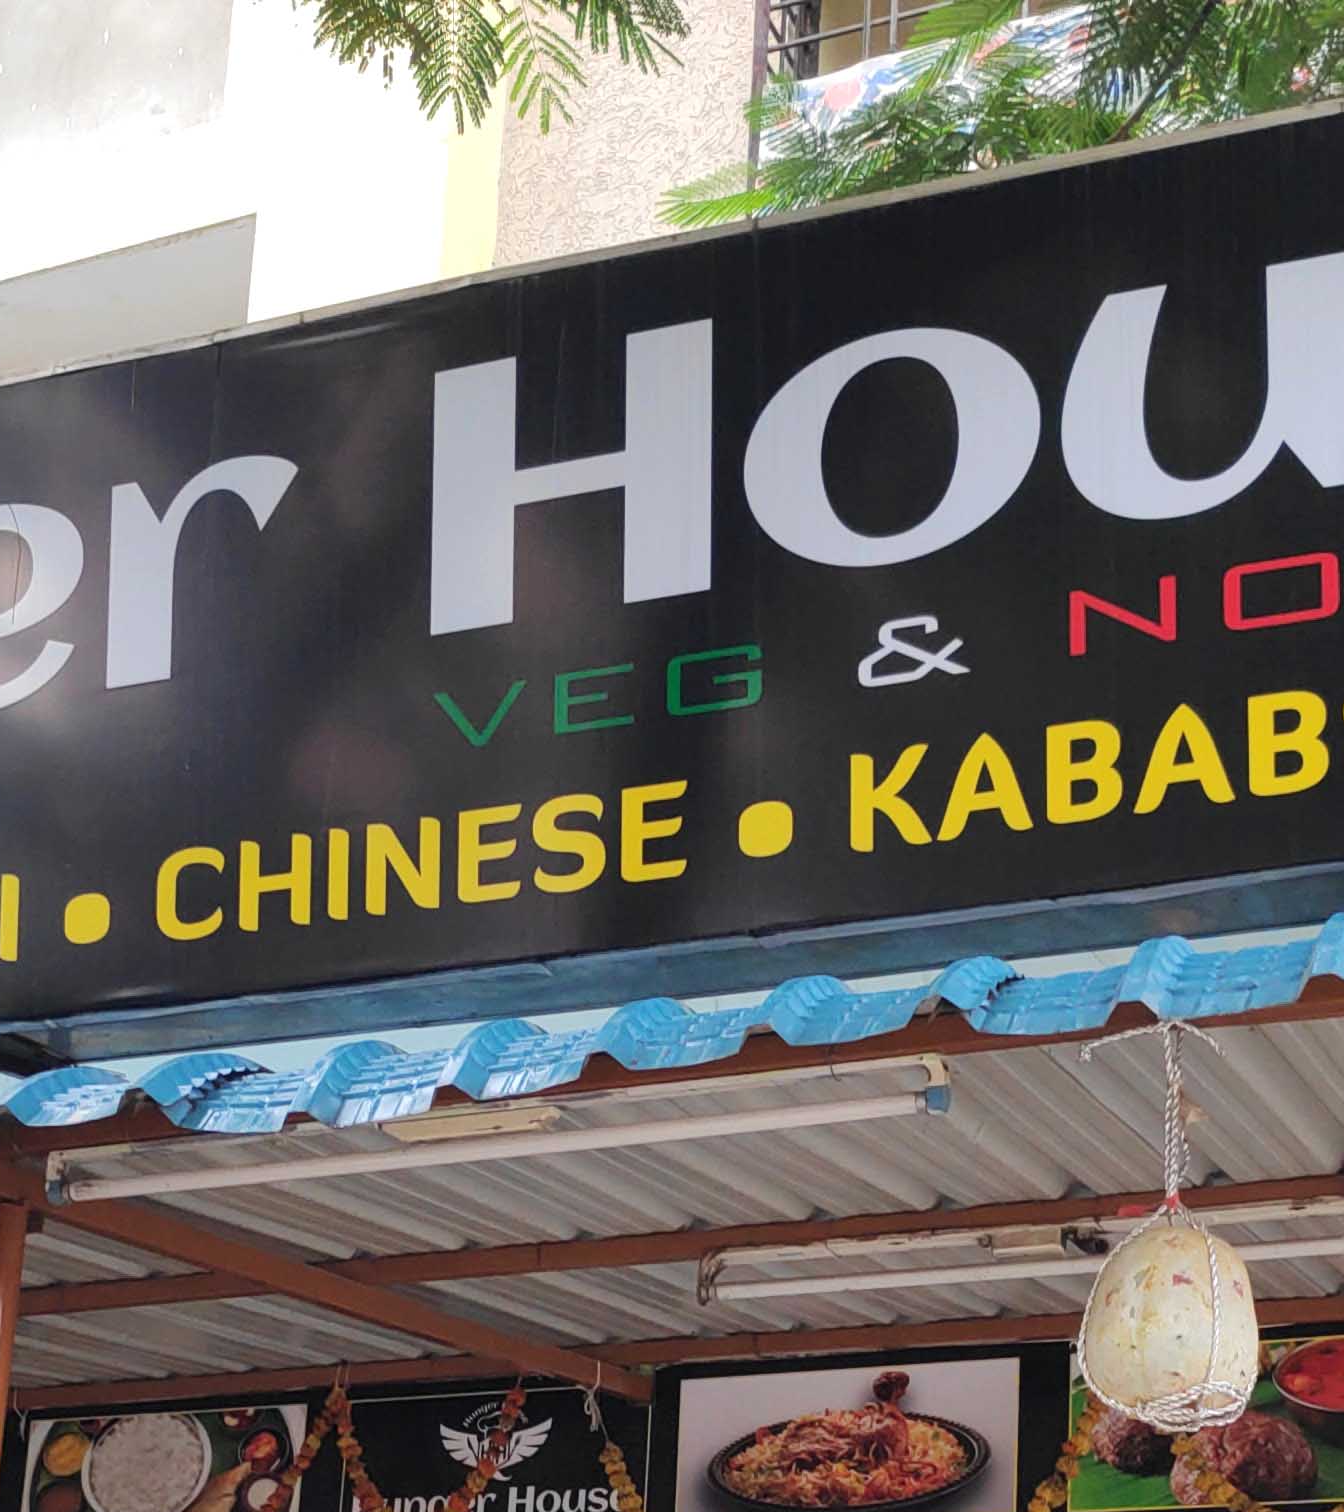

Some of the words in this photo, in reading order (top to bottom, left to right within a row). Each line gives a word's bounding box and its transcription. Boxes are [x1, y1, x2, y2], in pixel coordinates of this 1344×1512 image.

[435, 643, 764, 746] VEG
[859, 616, 970, 687] &
[156, 780, 689, 940] CHINESE
